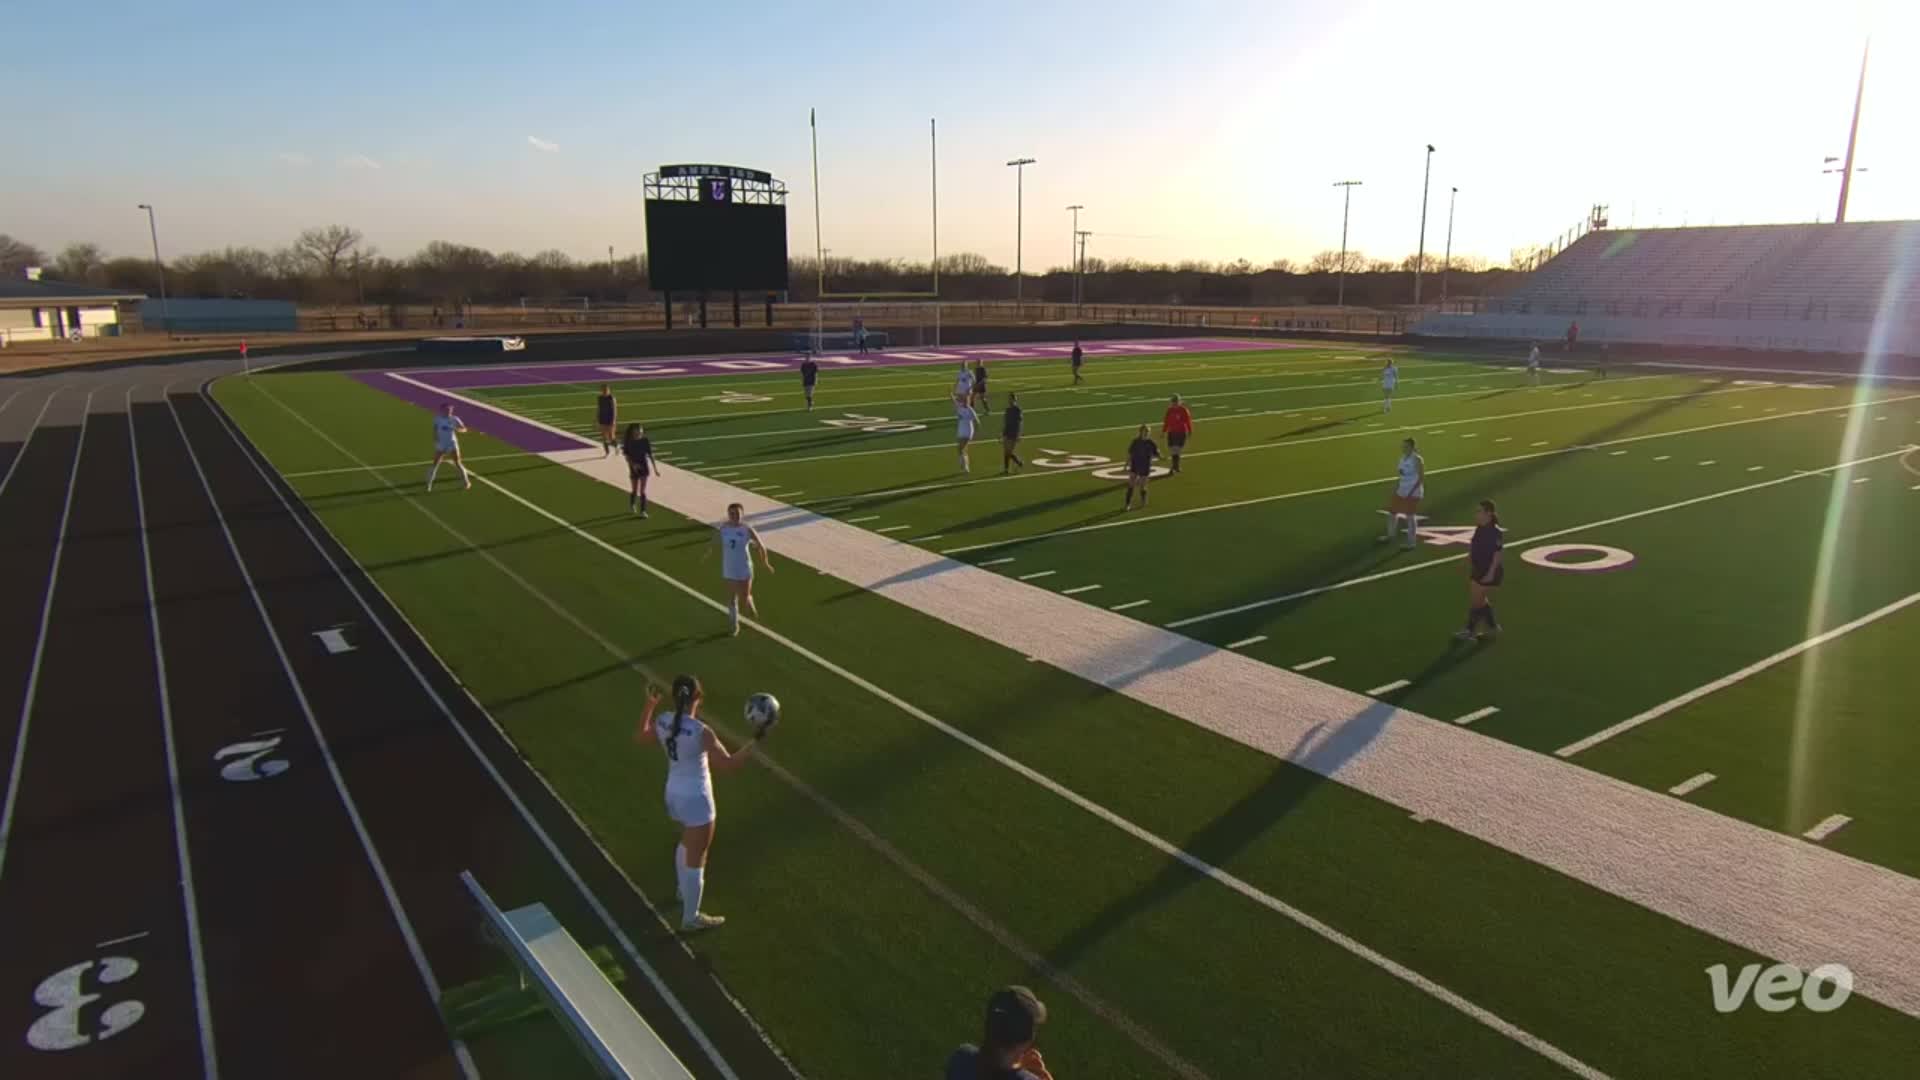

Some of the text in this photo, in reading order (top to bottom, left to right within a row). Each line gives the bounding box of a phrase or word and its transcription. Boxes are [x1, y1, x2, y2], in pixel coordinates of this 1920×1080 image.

[313, 628, 359, 654] 1
[214, 736, 290, 781] 2
[26, 956, 145, 1050] 3
